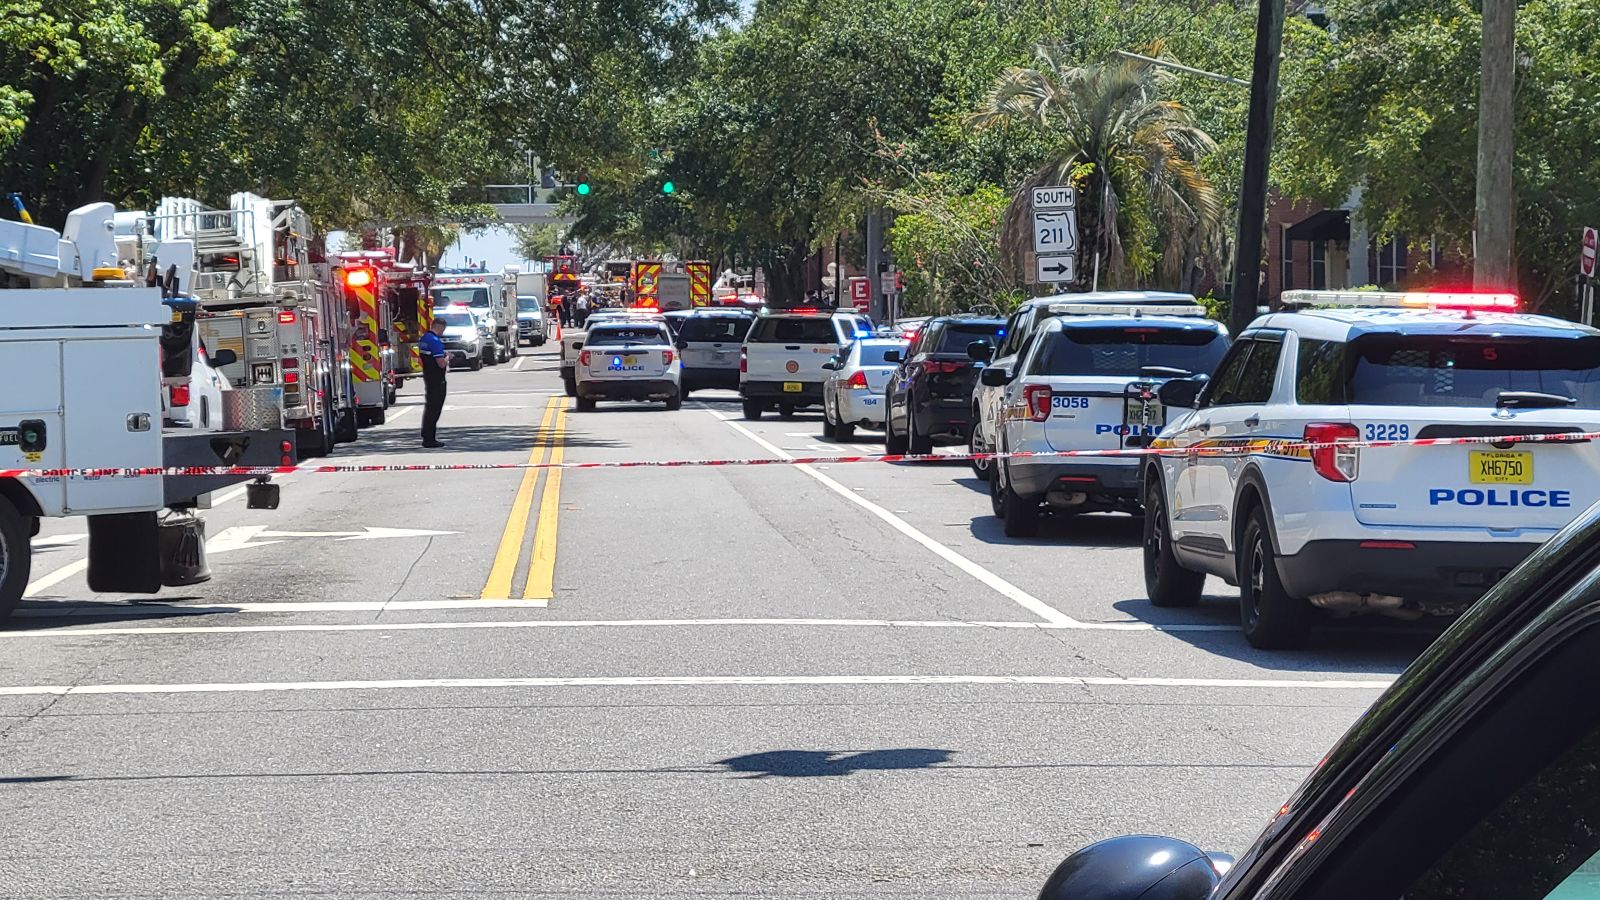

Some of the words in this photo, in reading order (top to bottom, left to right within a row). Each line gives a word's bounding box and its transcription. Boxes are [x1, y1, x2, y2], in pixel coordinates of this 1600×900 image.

[1036, 191, 1072, 204] SOUTH
[1040, 228, 1063, 244] 211
[855, 282, 867, 298] E
[1483, 347, 1498, 361] 5
[1053, 397, 1089, 409] 3058
[1365, 423, 1410, 441] 3229
[1481, 460, 1523, 476] XH6750
[1429, 488, 1572, 507] POLICE
